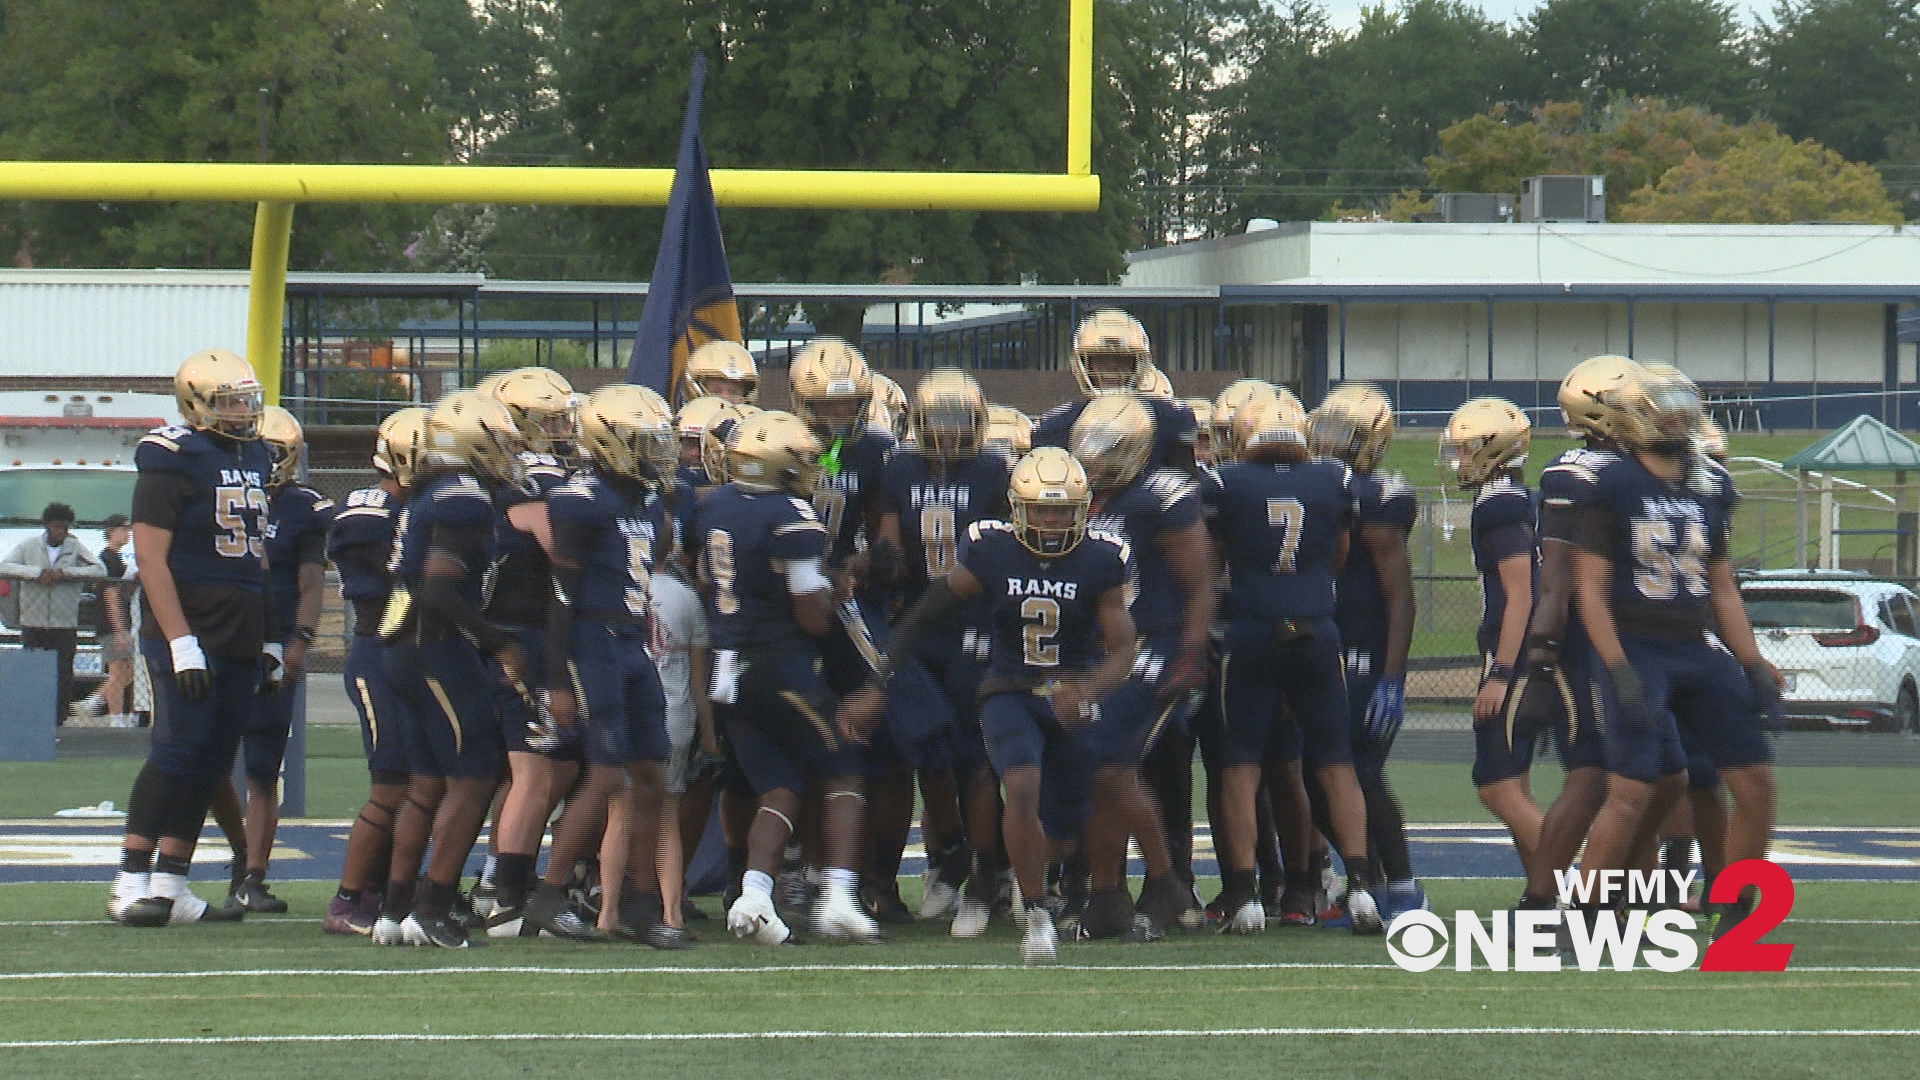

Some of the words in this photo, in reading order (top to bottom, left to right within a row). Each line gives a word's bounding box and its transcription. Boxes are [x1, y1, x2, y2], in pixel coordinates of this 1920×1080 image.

[220, 469, 261, 487] RAMS
[911, 483, 970, 506] RAMS
[215, 486, 270, 557] 53
[615, 516, 657, 539] RAMS
[1265, 496, 1306, 575] 7
[1007, 577, 1078, 600] RAMS
[1020, 596, 1061, 666] 2
